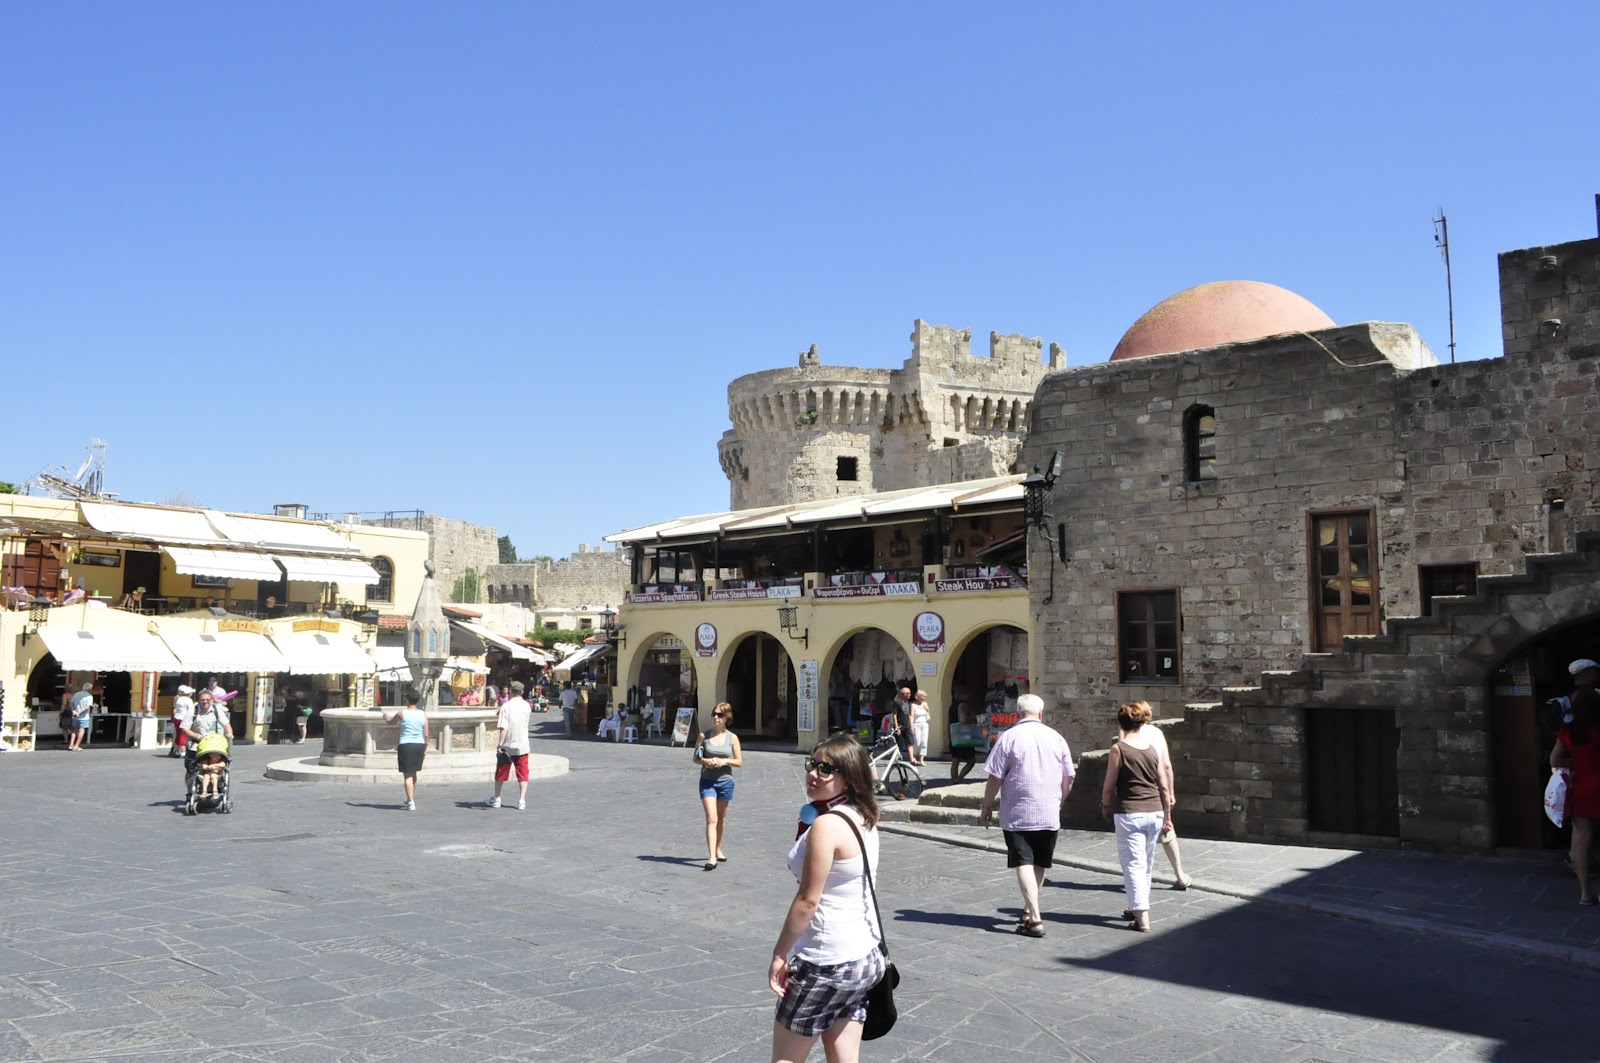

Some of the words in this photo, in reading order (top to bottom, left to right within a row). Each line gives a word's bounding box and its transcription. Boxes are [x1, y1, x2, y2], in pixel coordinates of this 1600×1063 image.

[885, 584, 916, 594] ΠΛΑΚΑ
[937, 580, 964, 591] Steak
[965, 580, 994, 590] Houe
[630, 595, 652, 603] Pizzeria
[660, 592, 698, 603] Spaghetteria
[730, 591, 747, 599] Steak
[747, 589, 767, 598] House
[769, 588, 791, 597] PLAKA
